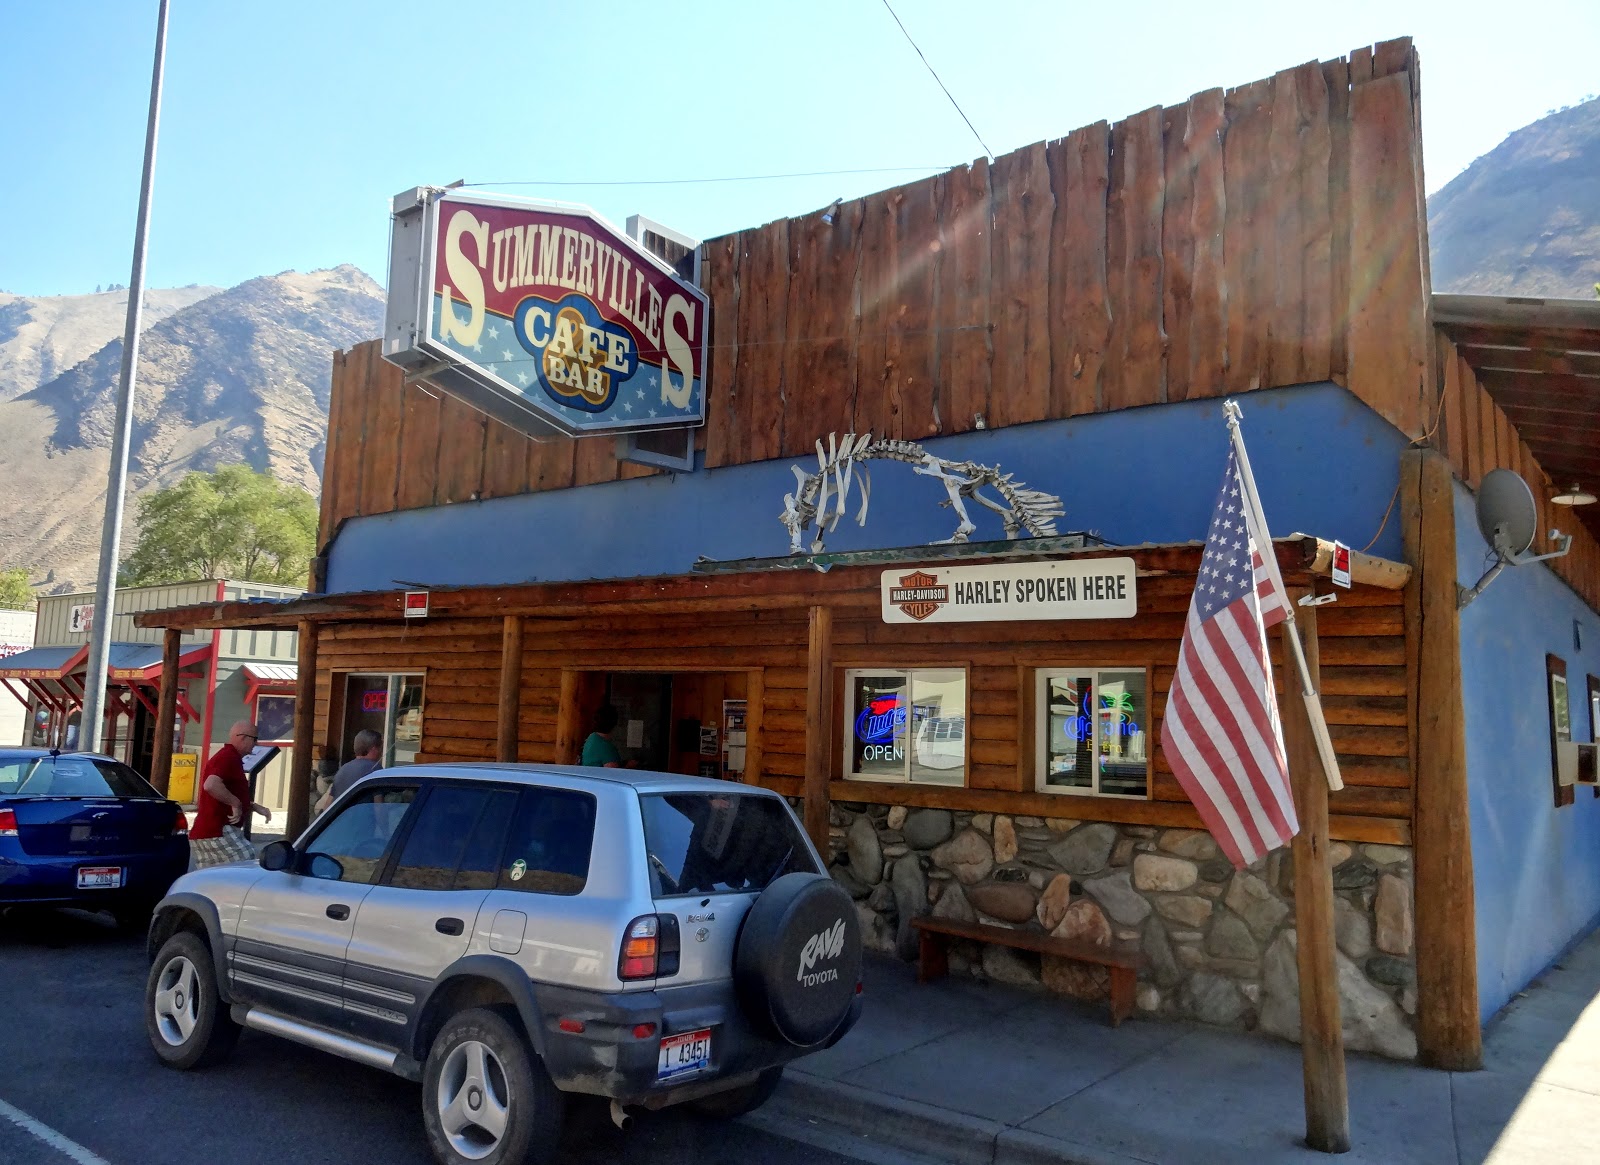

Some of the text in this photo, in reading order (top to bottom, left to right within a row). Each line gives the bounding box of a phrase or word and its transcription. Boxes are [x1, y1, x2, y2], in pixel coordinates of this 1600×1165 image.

[440, 210, 695, 408] SUMMERVILLES
[525, 307, 629, 374] CAFE
[548, 355, 604, 396] BAR
[904, 574, 932, 586] MOTOR
[893, 589, 945, 600] HARLEY-DAVIDSON
[955, 575, 1126, 604] HARLEY SPOKEN HERE
[904, 603, 934, 617] CYCLES
[364, 692, 388, 709] OPE
[1064, 716, 1138, 742] Coona
[864, 745, 902, 761] OPEN
[175, 758, 195, 767] SIGNS
[686, 912, 715, 923] RAV4
[803, 968, 838, 988] TOYOTA
[679, 1040, 707, 1064] 43451
